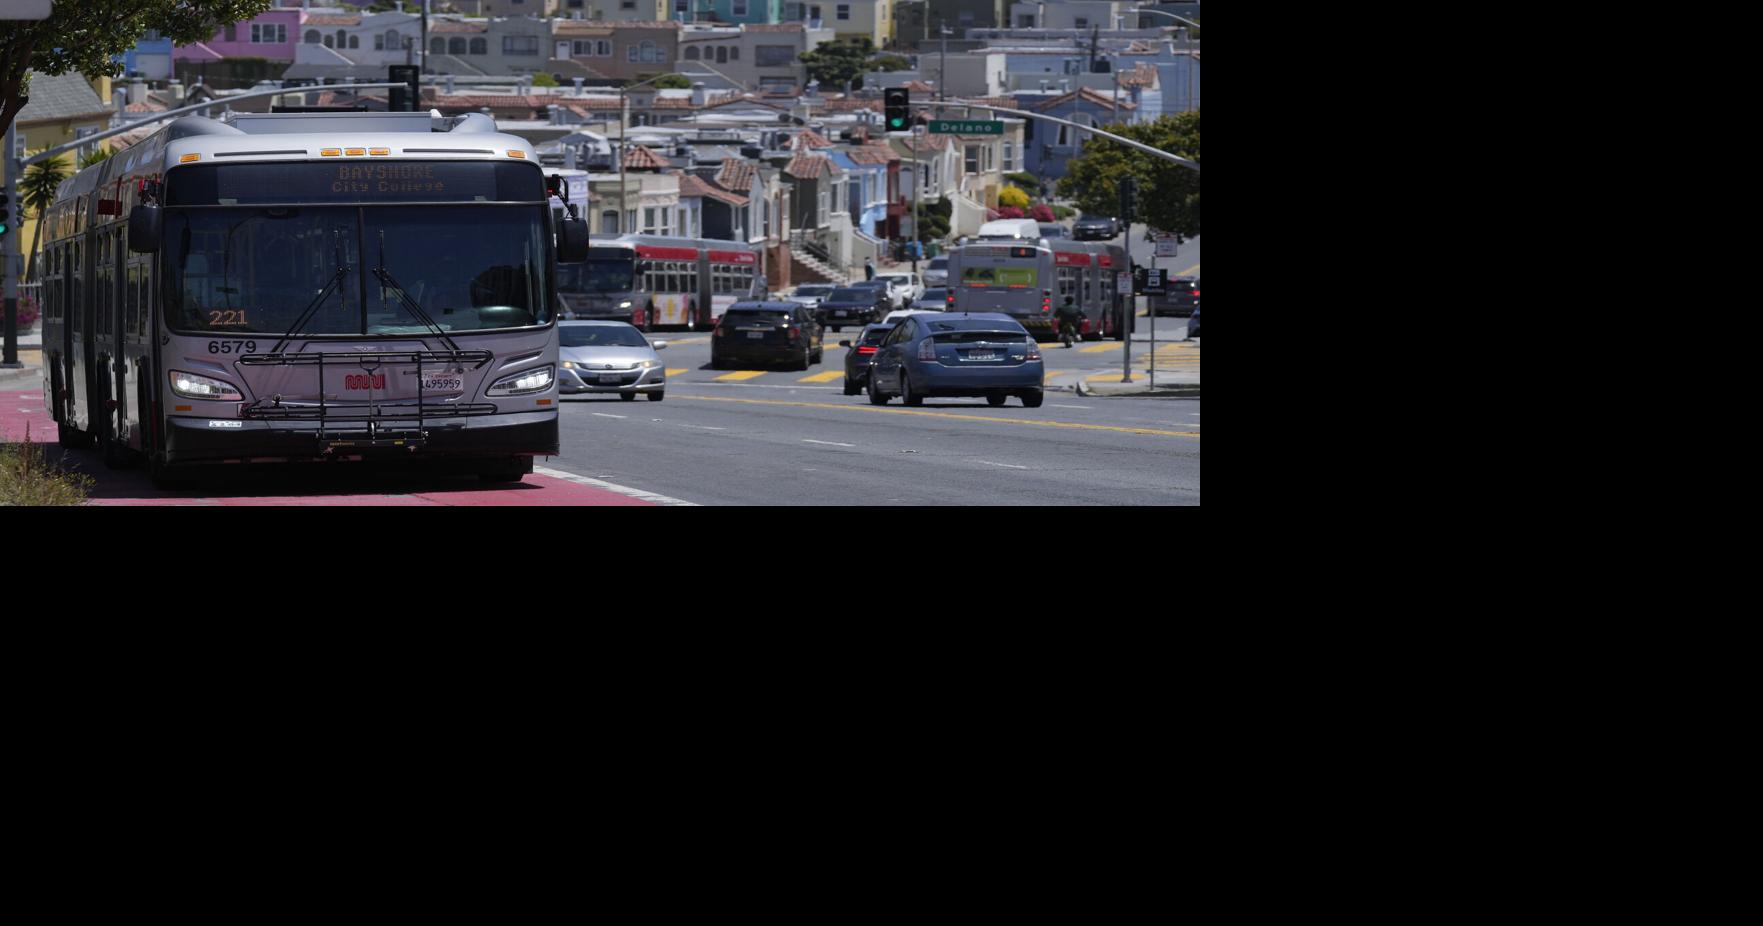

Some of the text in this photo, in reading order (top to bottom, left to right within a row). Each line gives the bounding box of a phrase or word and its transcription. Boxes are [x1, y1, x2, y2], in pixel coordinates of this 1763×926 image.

[940, 122, 992, 132] Delano
[338, 164, 434, 179] BAYSHORE
[332, 181, 369, 193] City
[209, 310, 247, 325] 221
[208, 340, 256, 354] 6579
